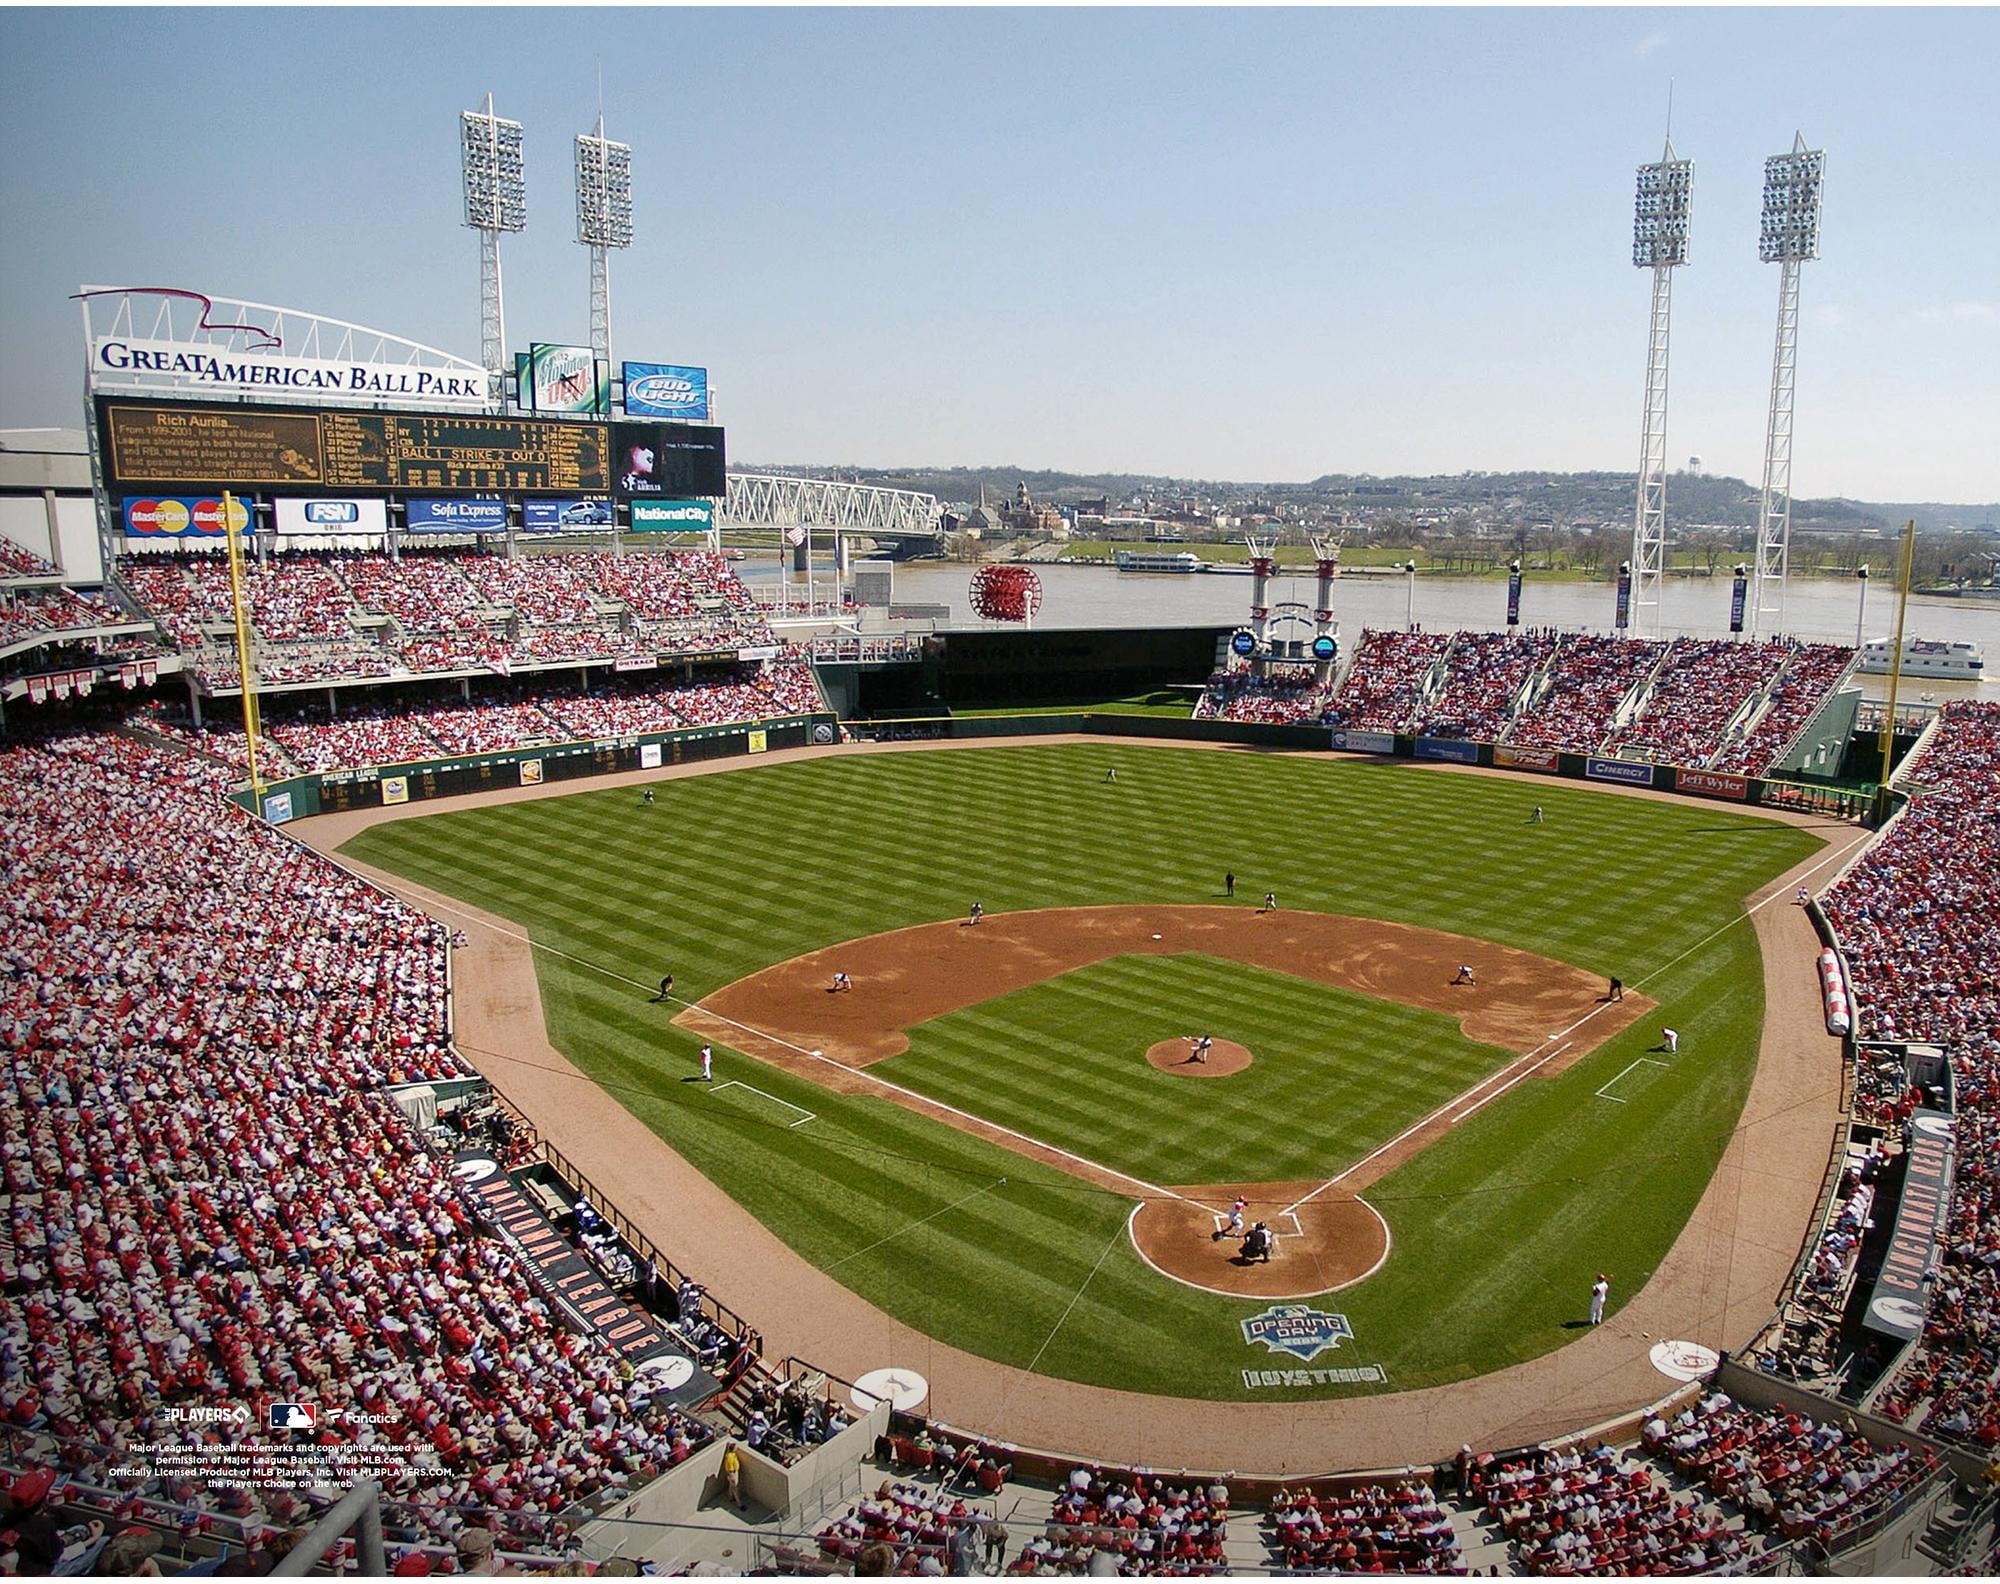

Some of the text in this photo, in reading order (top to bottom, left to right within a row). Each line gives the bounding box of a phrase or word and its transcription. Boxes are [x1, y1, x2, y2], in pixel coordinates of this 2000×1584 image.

[101, 342, 480, 397] GREAT AMERICAN BALL PARK
[647, 379, 693, 392] BUD
[640, 390, 700, 404] LIGHT
[157, 413, 187, 426] Rich
[402, 447, 545, 461] BALL 1 STRIKE 2 OUT 0
[313, 503, 352, 521] FSN
[431, 503, 502, 518] Sofa Express
[634, 507, 709, 523] National City
[1595, 763, 1645, 778] CINERGY
[1679, 773, 1705, 785] Jeff
[1707, 776, 1744, 791] Wyler
[1910, 1137, 1946, 1178] REDS
[478, 1179, 661, 1353] NATIONAL LEAGUE
[1250, 1317, 1342, 1335] OPENING
[1276, 1327, 1319, 1338] DAY
